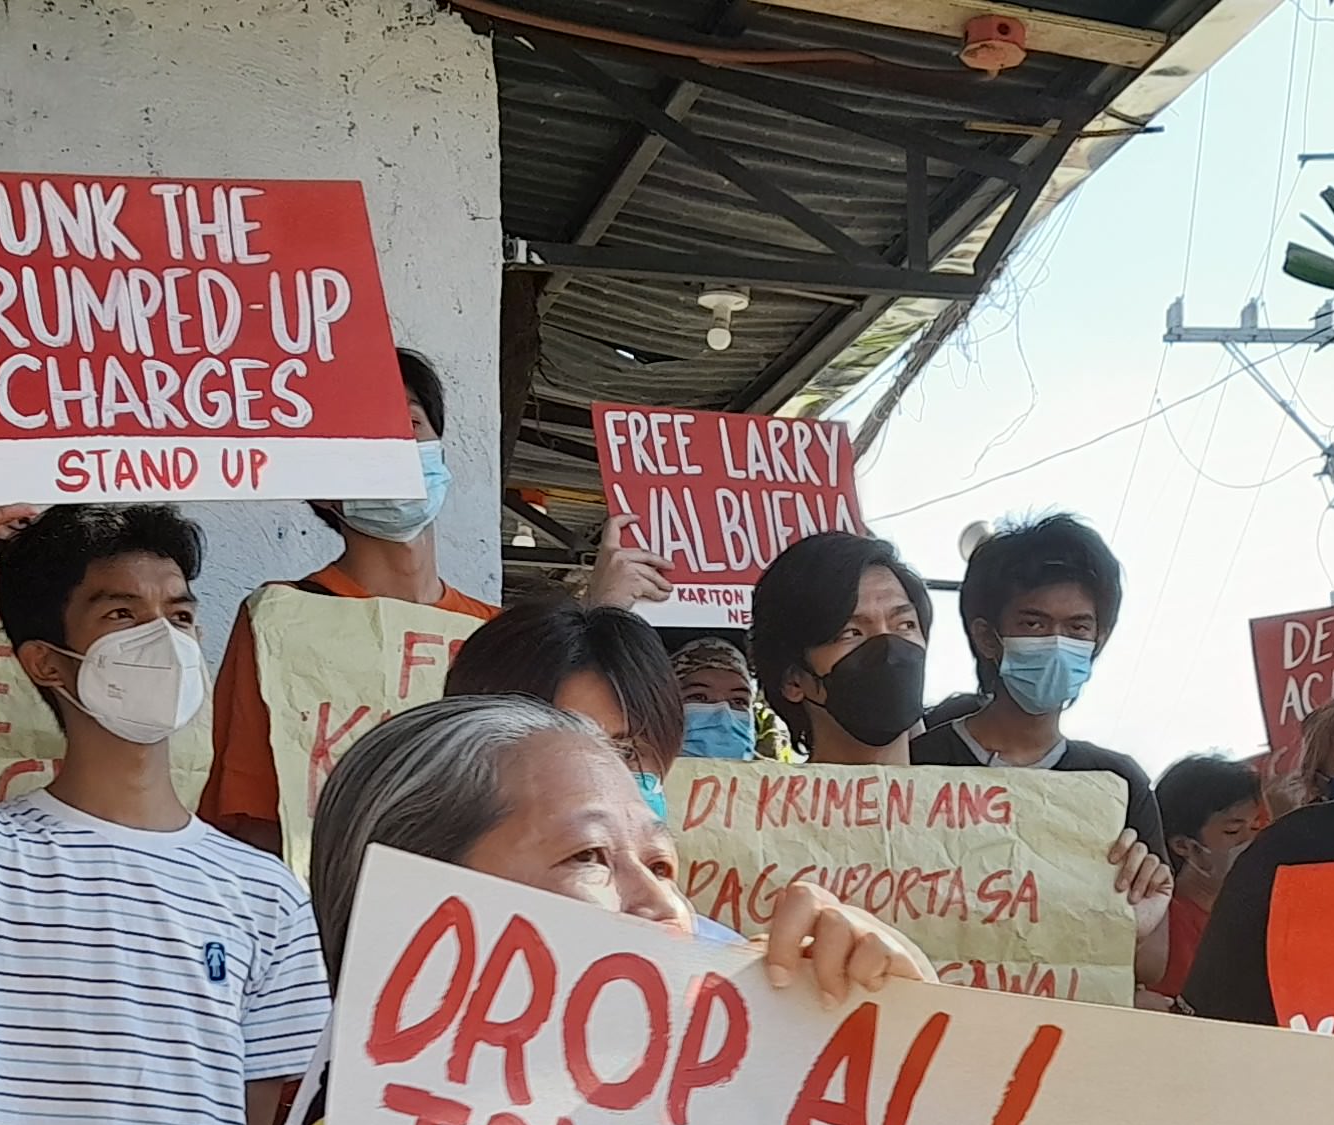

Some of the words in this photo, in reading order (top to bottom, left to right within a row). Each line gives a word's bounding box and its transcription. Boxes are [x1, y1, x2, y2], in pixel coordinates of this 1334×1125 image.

[149, 182, 272, 265] THE
[55, 447, 199, 493] STAND
[221, 448, 269, 490] UP
[604, 410, 703, 475] FREE
[718, 417, 840, 487] LARRY
[677, 587, 745, 607] KARITON
[682, 774, 738, 832] DI
[754, 774, 915, 831] KRIMEN
[925, 781, 1012, 831] ANG
[366, 895, 751, 1125] DROP
